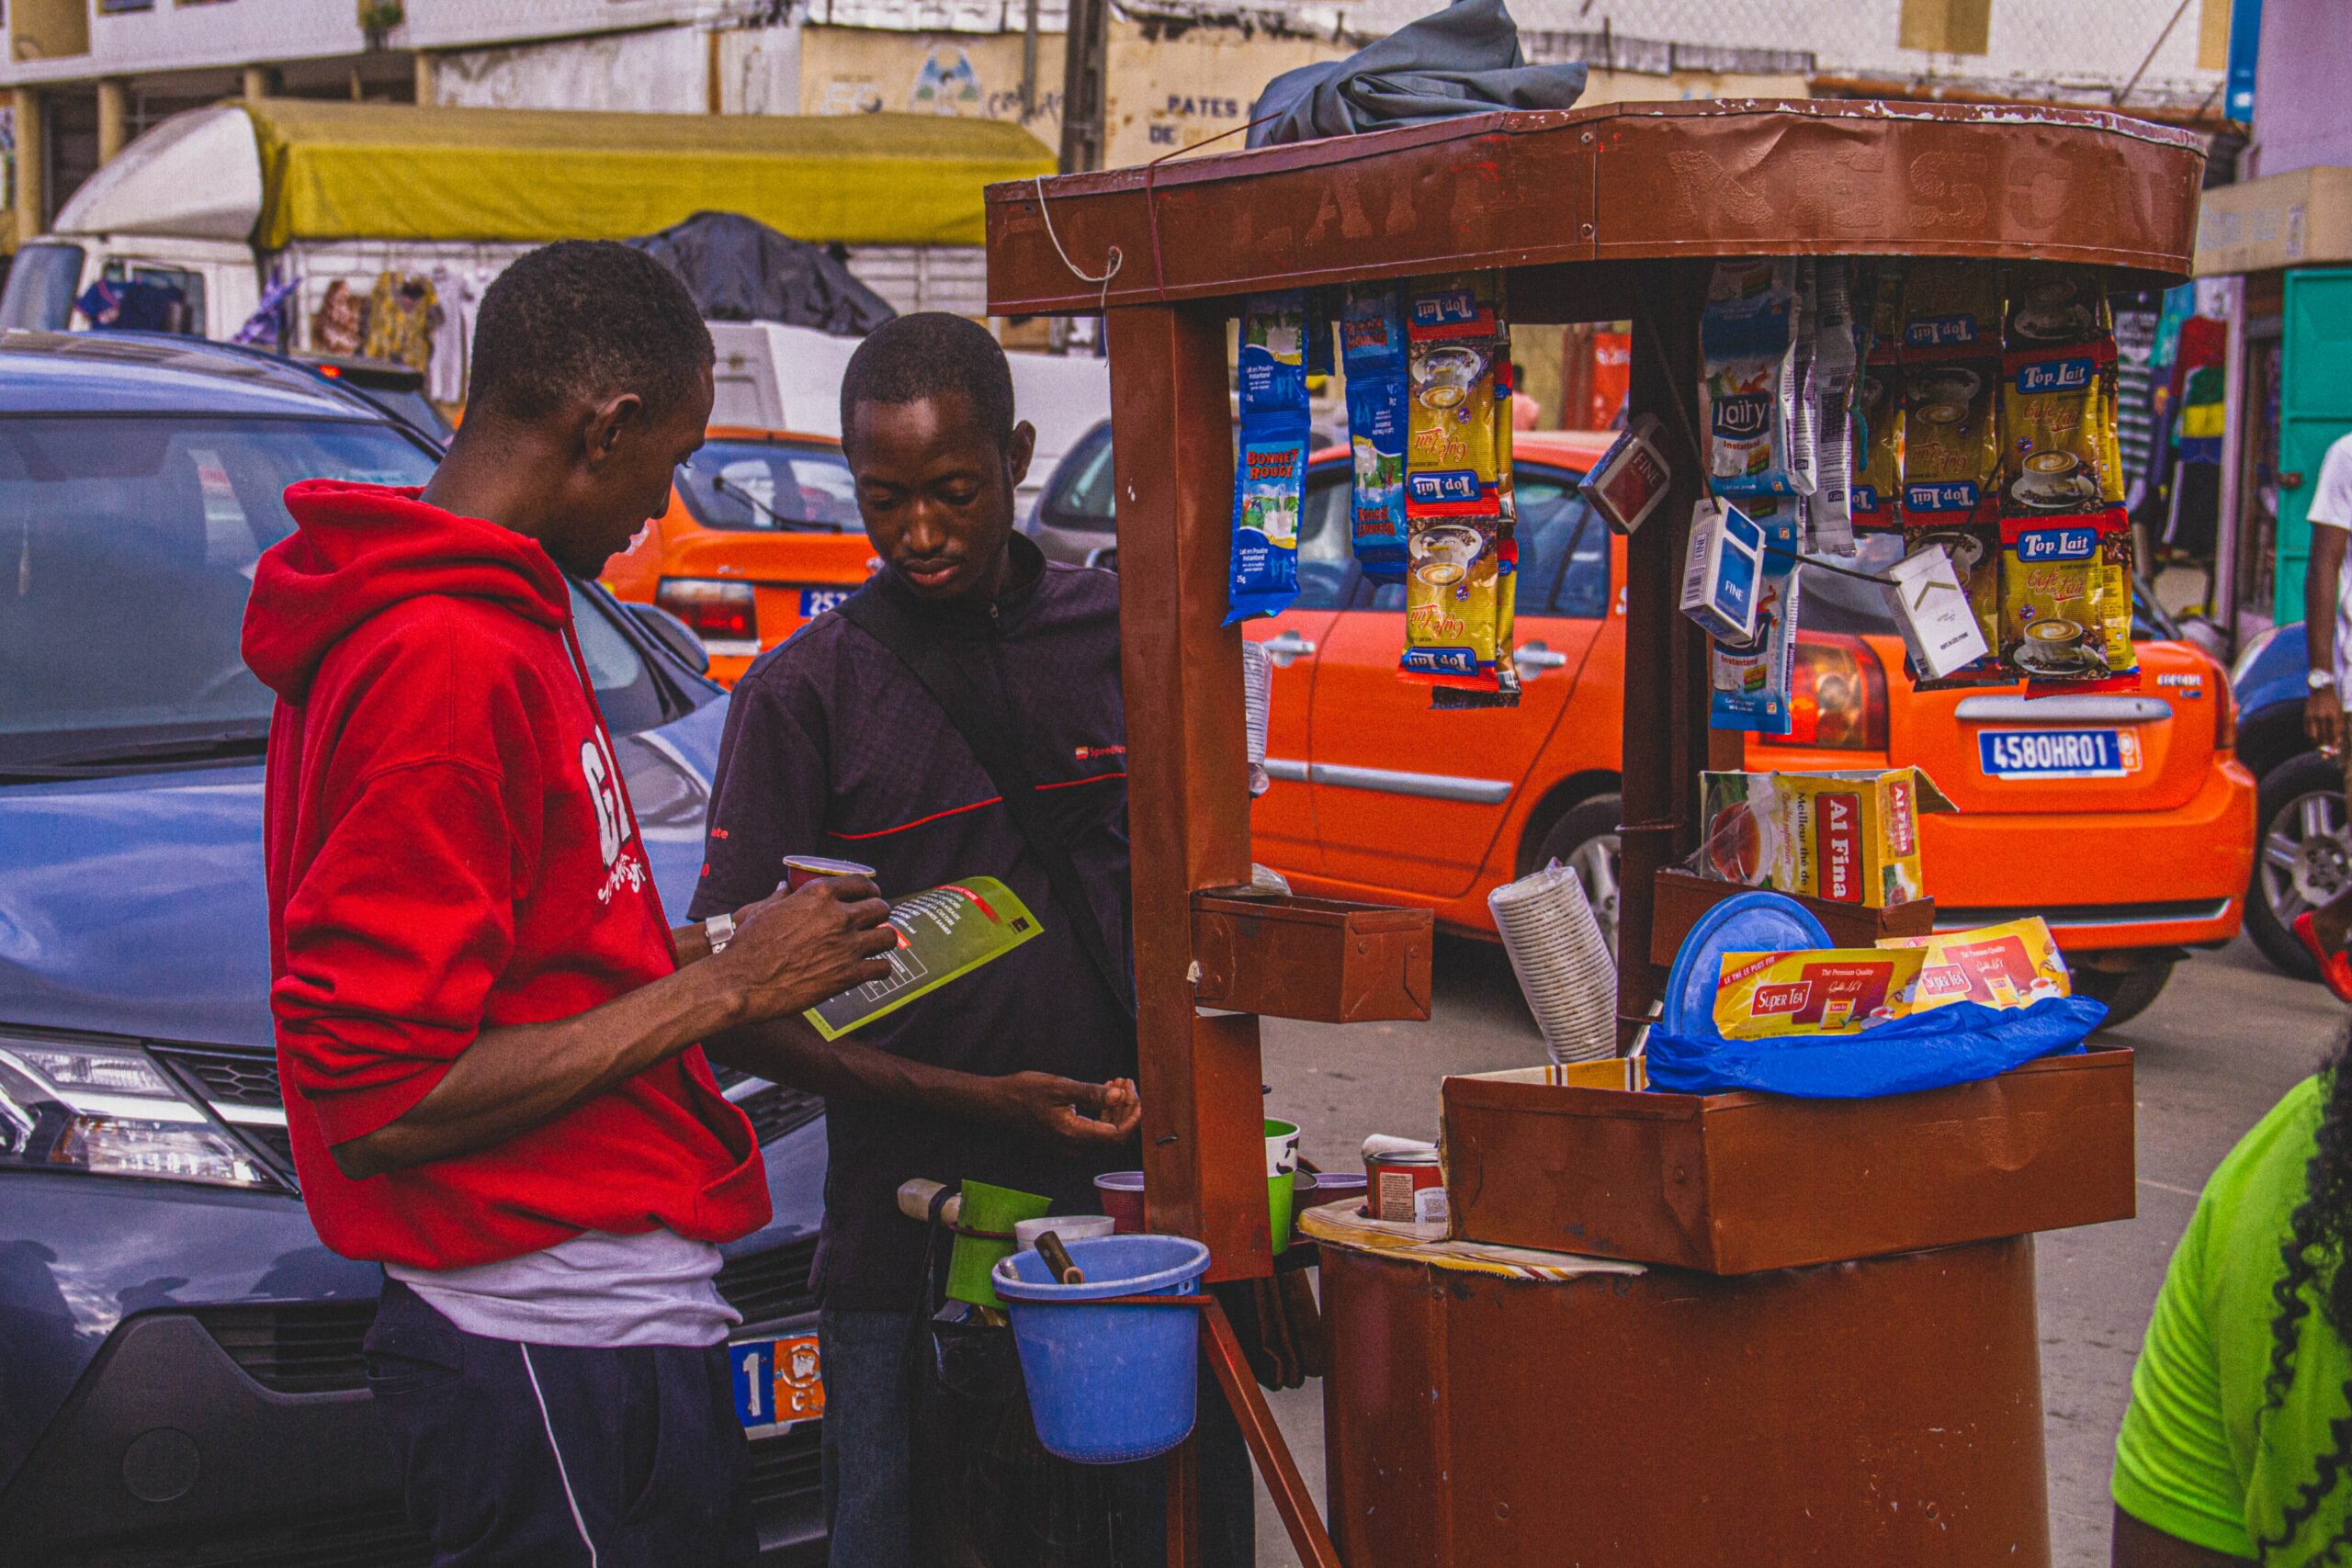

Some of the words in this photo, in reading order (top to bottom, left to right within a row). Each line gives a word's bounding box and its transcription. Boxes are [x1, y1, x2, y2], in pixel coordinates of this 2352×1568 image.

[1167, 95, 1238, 118] PATES
[1148, 122, 1180, 146] DE
[2056, 363, 2086, 385] Lait
[1246, 447, 1300, 467] BONNET
[1249, 462, 1294, 481] ROUGE
[1634, 452, 1661, 486] FINE
[1413, 477, 1444, 499] Lait
[1445, 476, 1476, 497] Top
[1943, 487, 1974, 506] Top
[1910, 488, 1941, 509] Lait
[2058, 532, 2088, 555] Lait
[1724, 580, 1745, 603] FINE
[1440, 653, 1472, 672] Top
[1994, 734, 2108, 769] 4580HR01
[1797, 792, 1809, 843] Meilleur
[1830, 798, 1849, 831] Al
[1800, 847, 1810, 867] thé
[1831, 838, 1849, 898] Fina
[1800, 869, 1809, 886] de
[1724, 976, 1731, 986] LE
[1732, 970, 1743, 982] THÉ
[1743, 967, 1750, 977] LE
[1750, 960, 1766, 974] PLUS
